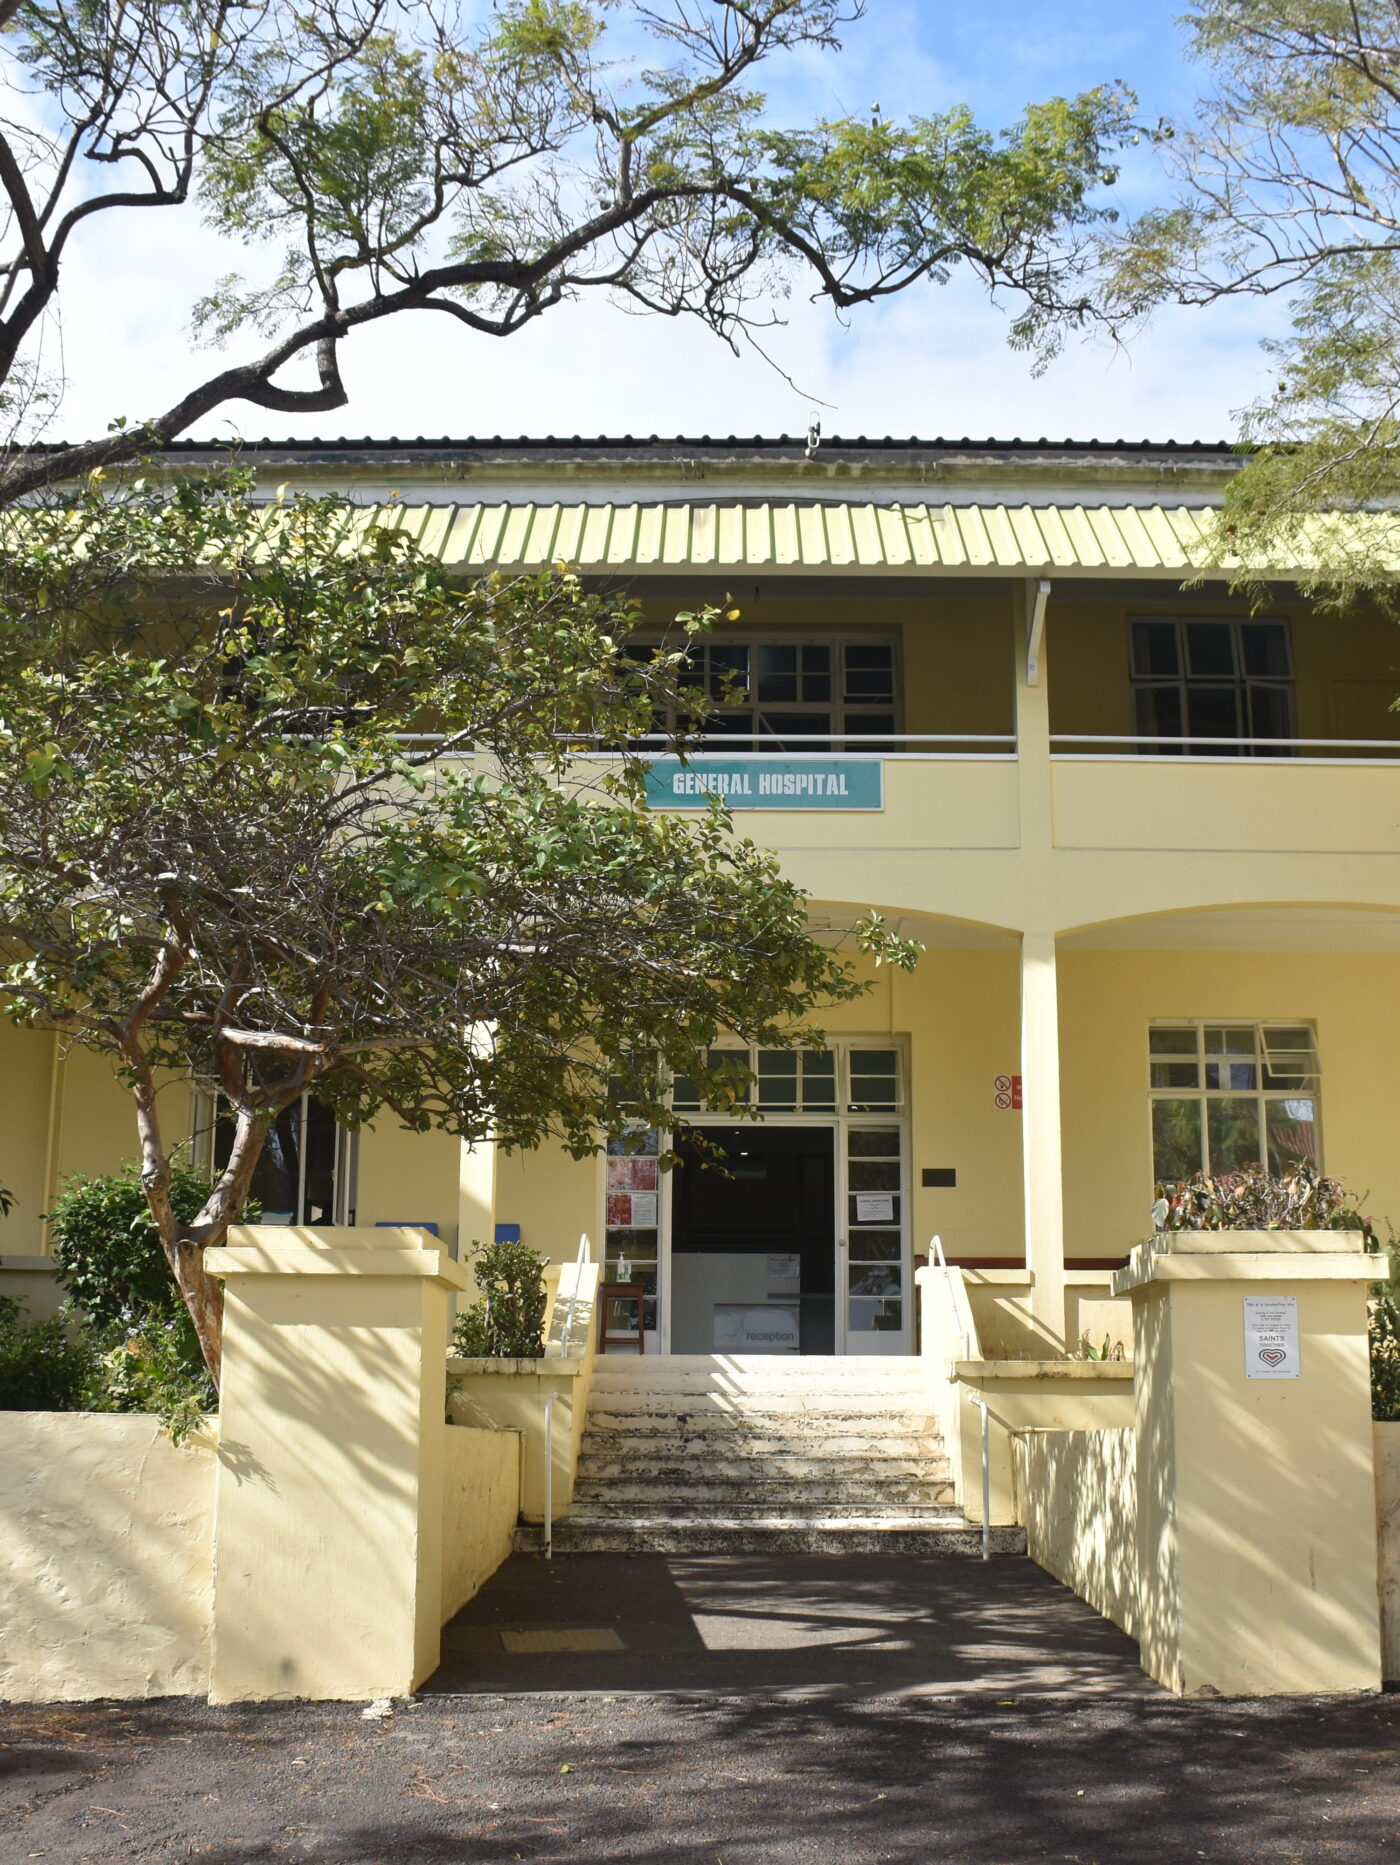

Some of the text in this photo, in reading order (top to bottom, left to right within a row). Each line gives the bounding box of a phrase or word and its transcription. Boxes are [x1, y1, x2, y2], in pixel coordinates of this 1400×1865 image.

[673, 773, 849, 795] GENERAL HOSPITAL
[746, 1331, 795, 1343] reception
